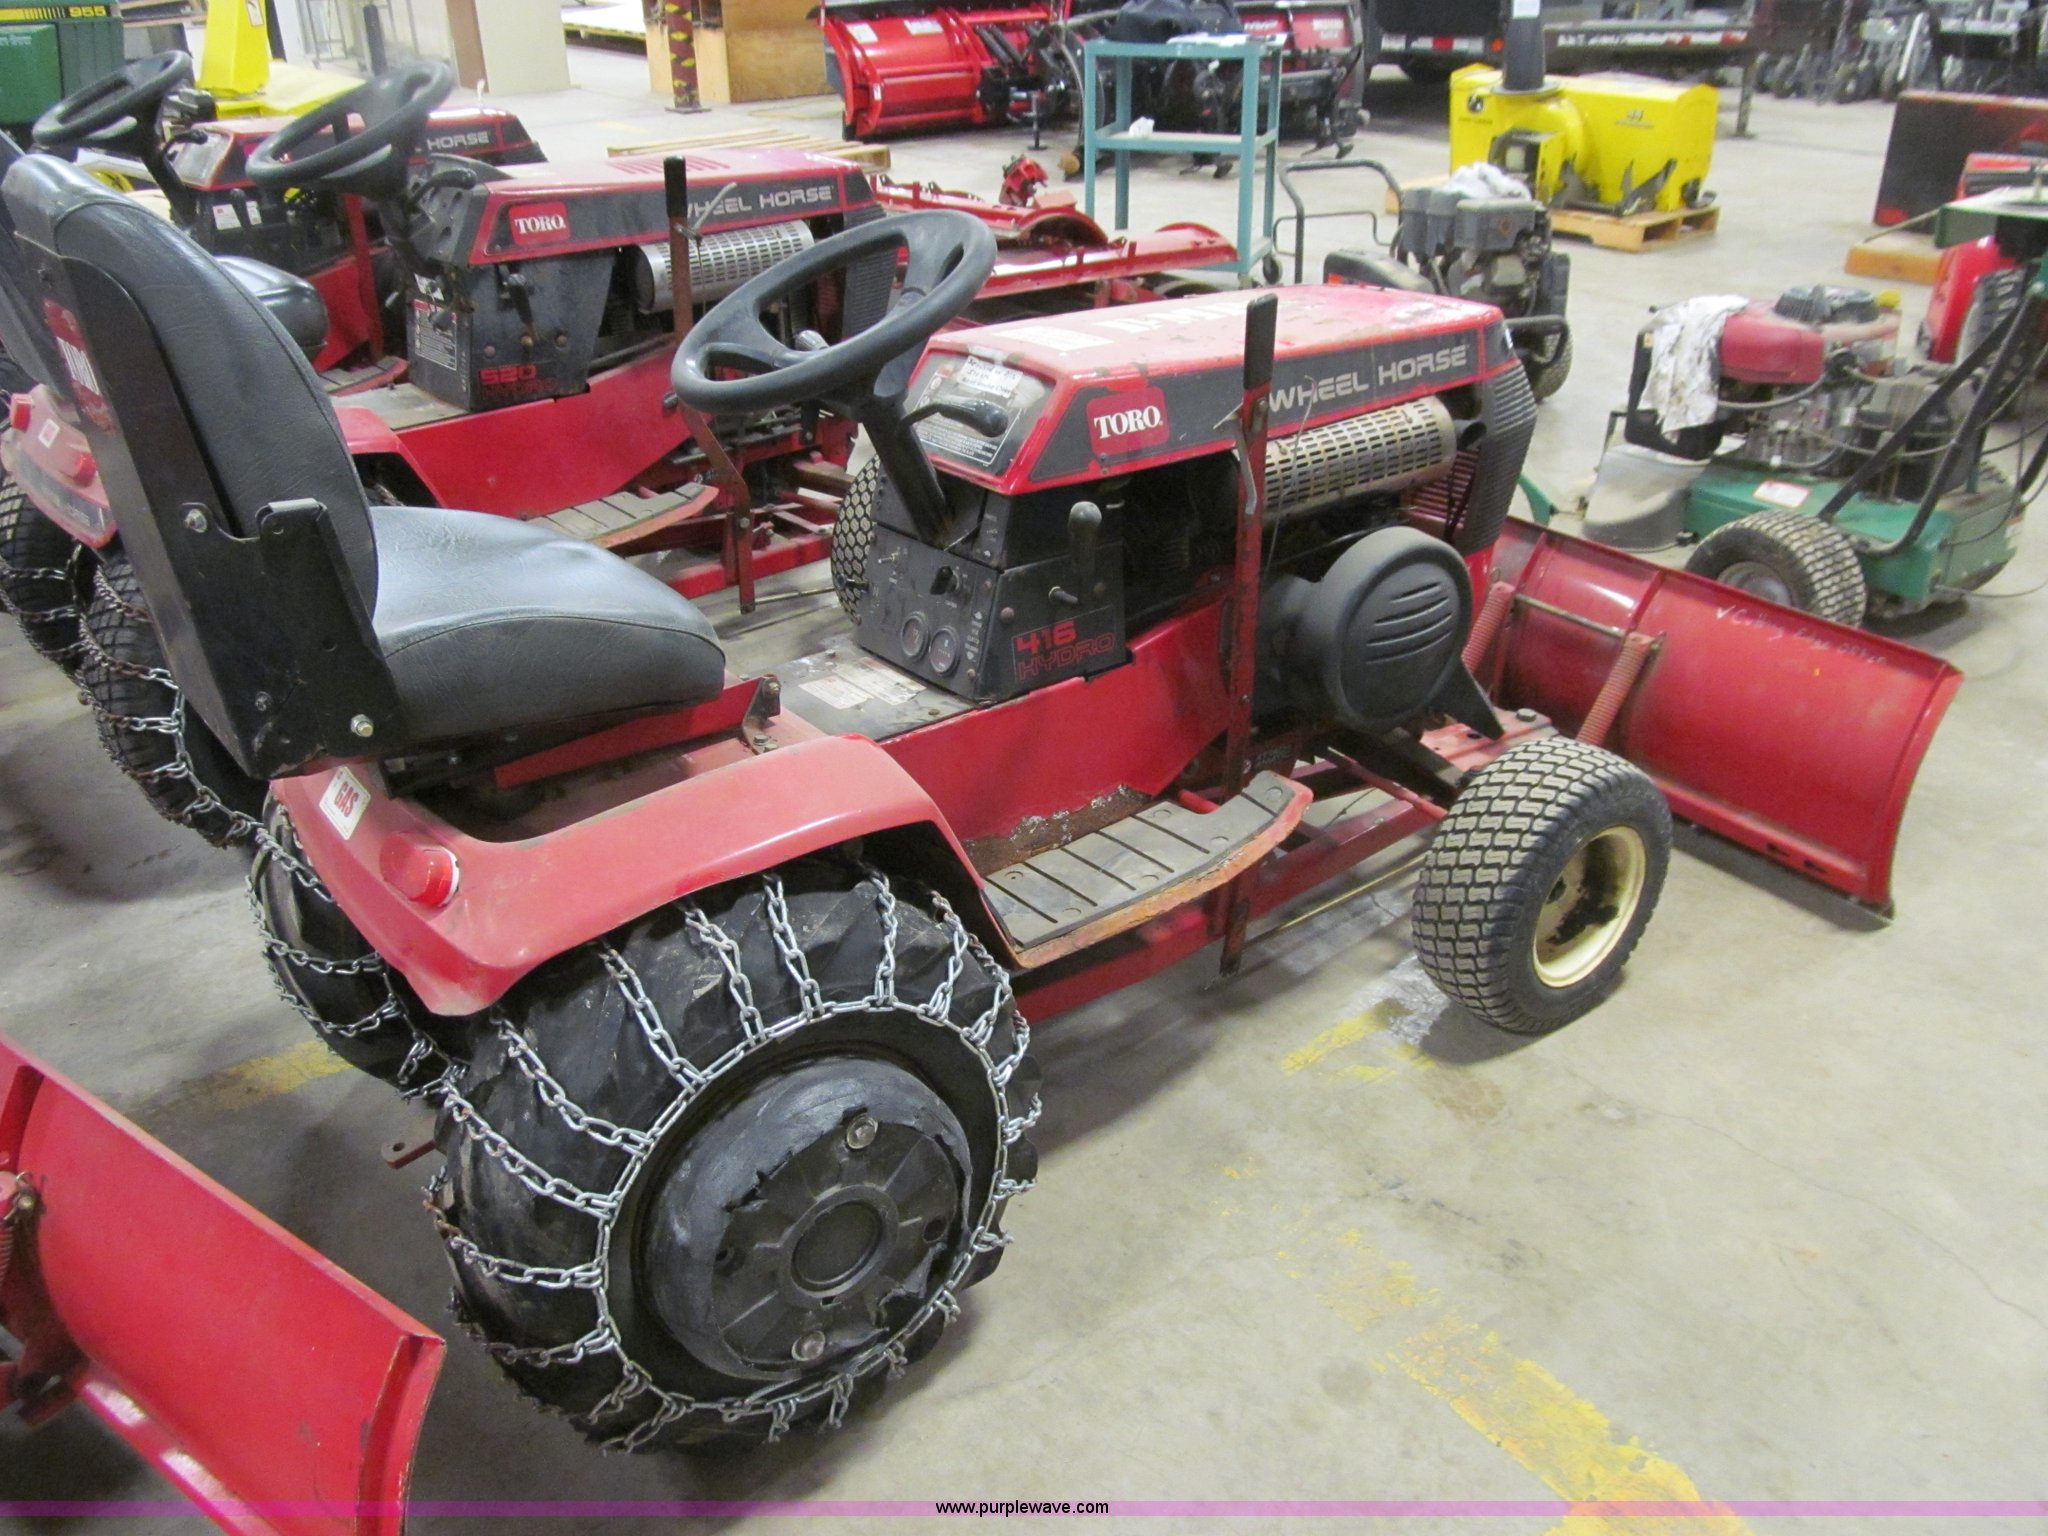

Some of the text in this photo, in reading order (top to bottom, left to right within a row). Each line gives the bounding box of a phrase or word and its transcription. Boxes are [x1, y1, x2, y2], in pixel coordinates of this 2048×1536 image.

[69, 5, 107, 18] 955
[427, 131, 490, 151] HORSE
[687, 187, 832, 219] HEEL HORSE
[514, 214, 567, 235] TORO
[480, 363, 537, 385] 520
[1269, 344, 1467, 412] WHEEL HORSE
[1094, 404, 1161, 438] TORO
[1016, 620, 1077, 655] 416
[1017, 632, 1116, 684] HYDRO
[334, 781, 360, 818] GAS
